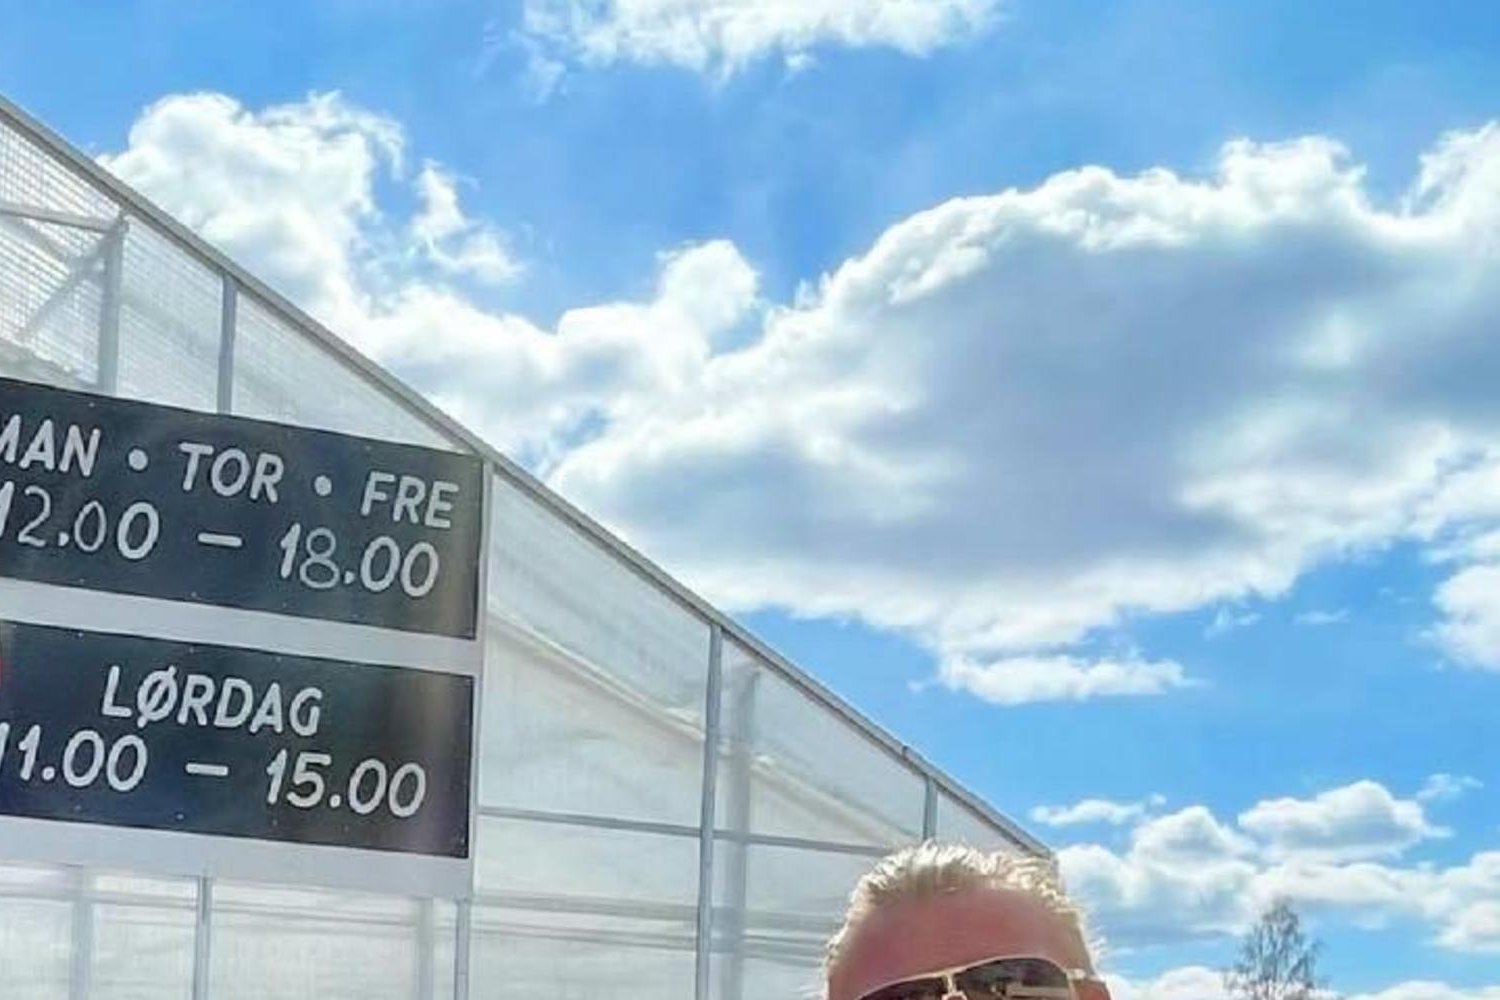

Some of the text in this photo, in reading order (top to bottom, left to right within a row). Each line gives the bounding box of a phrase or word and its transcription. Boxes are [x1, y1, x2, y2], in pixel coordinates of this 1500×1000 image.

[179, 442, 285, 503] TOR
[361, 471, 460, 529] FRE
[280, 523, 440, 597] 18.00
[101, 665, 323, 736] LØRDAG
[266, 748, 426, 818] 15.00
